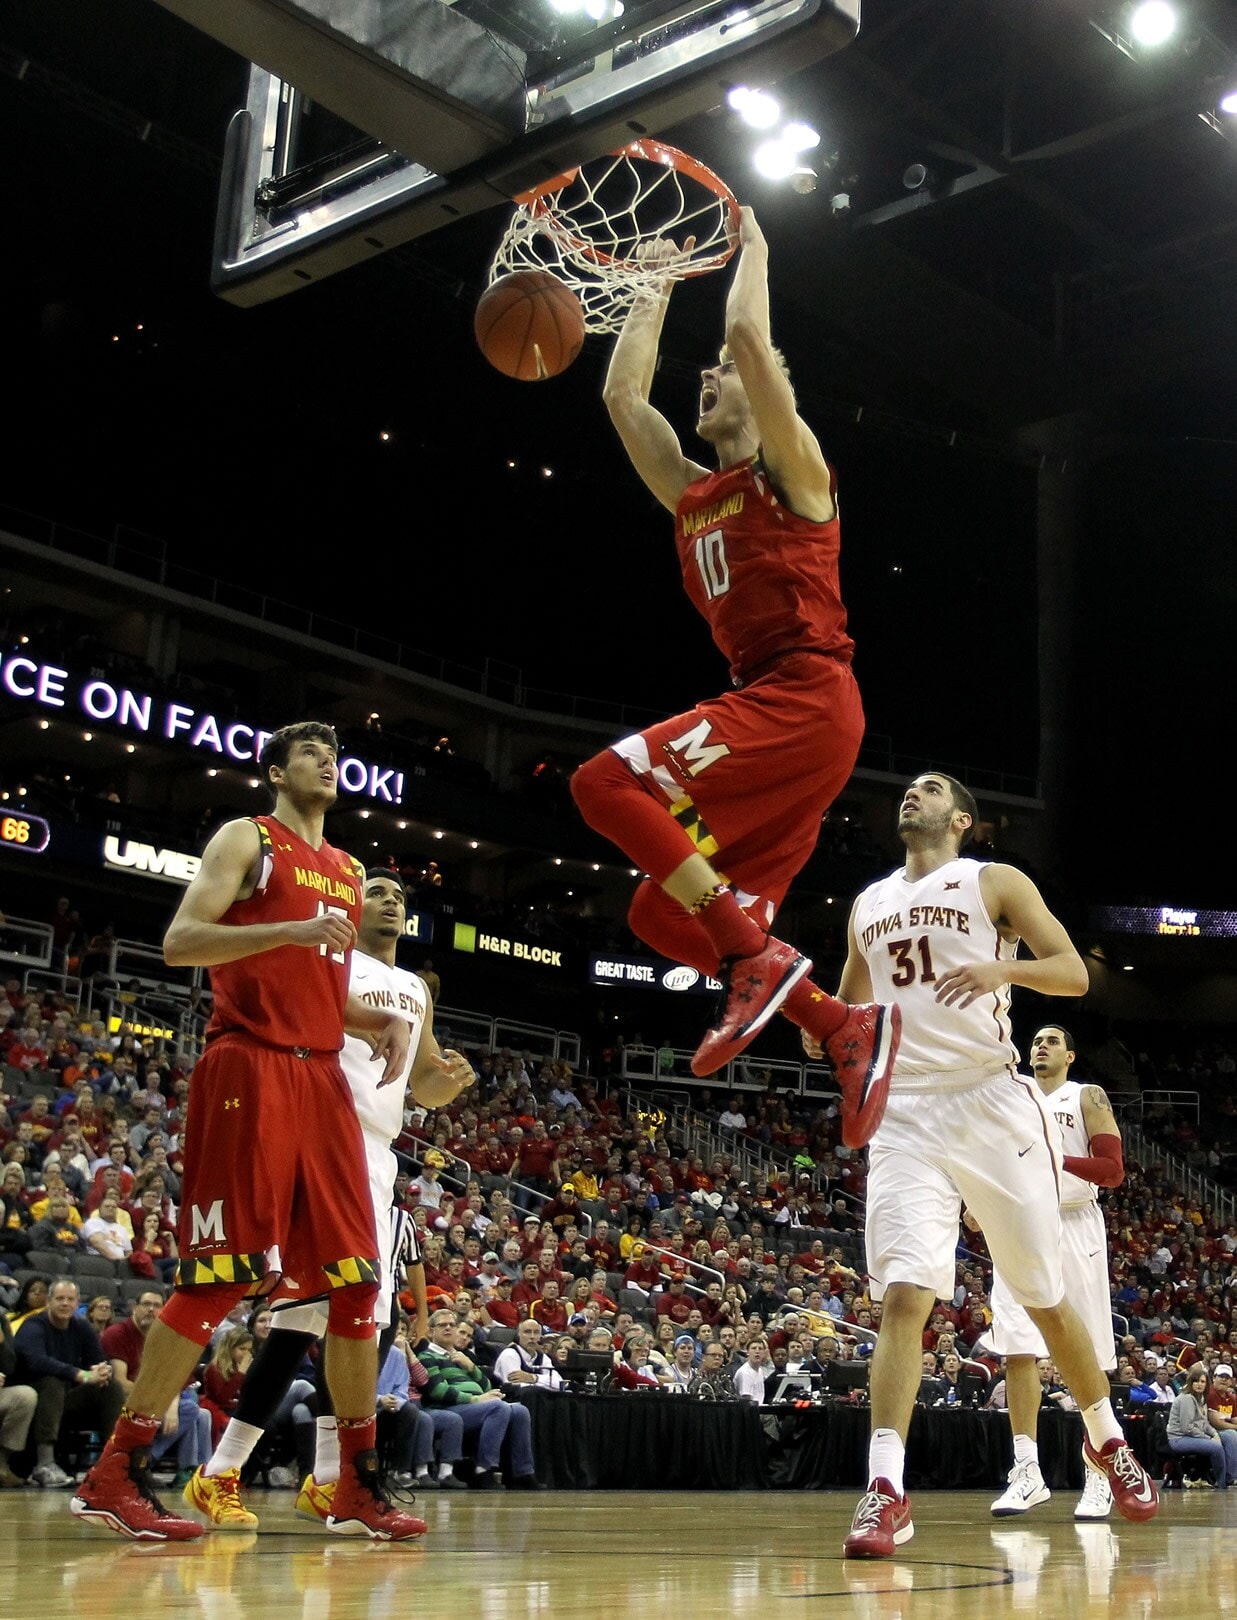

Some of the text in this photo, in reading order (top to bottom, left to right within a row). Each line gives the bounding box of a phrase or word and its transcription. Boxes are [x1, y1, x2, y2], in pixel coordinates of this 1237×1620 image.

[681, 492, 745, 538] MARYLAND
[695, 529, 731, 601] 10
[0, 651, 69, 707] CE
[81, 680, 152, 732] ON
[668, 718, 731, 778] M
[3, 817, 31, 843] 66
[293, 866, 357, 907] MARYLAND
[479, 933, 562, 968] H&R BLOCK
[862, 905, 970, 952] IOWA STATE
[594, 959, 656, 983] GREAT TASTE.
[887, 935, 937, 987] 31
[358, 989, 397, 1009] OWA
[1053, 1111, 1075, 1130] TE
[189, 1199, 228, 1246] M
